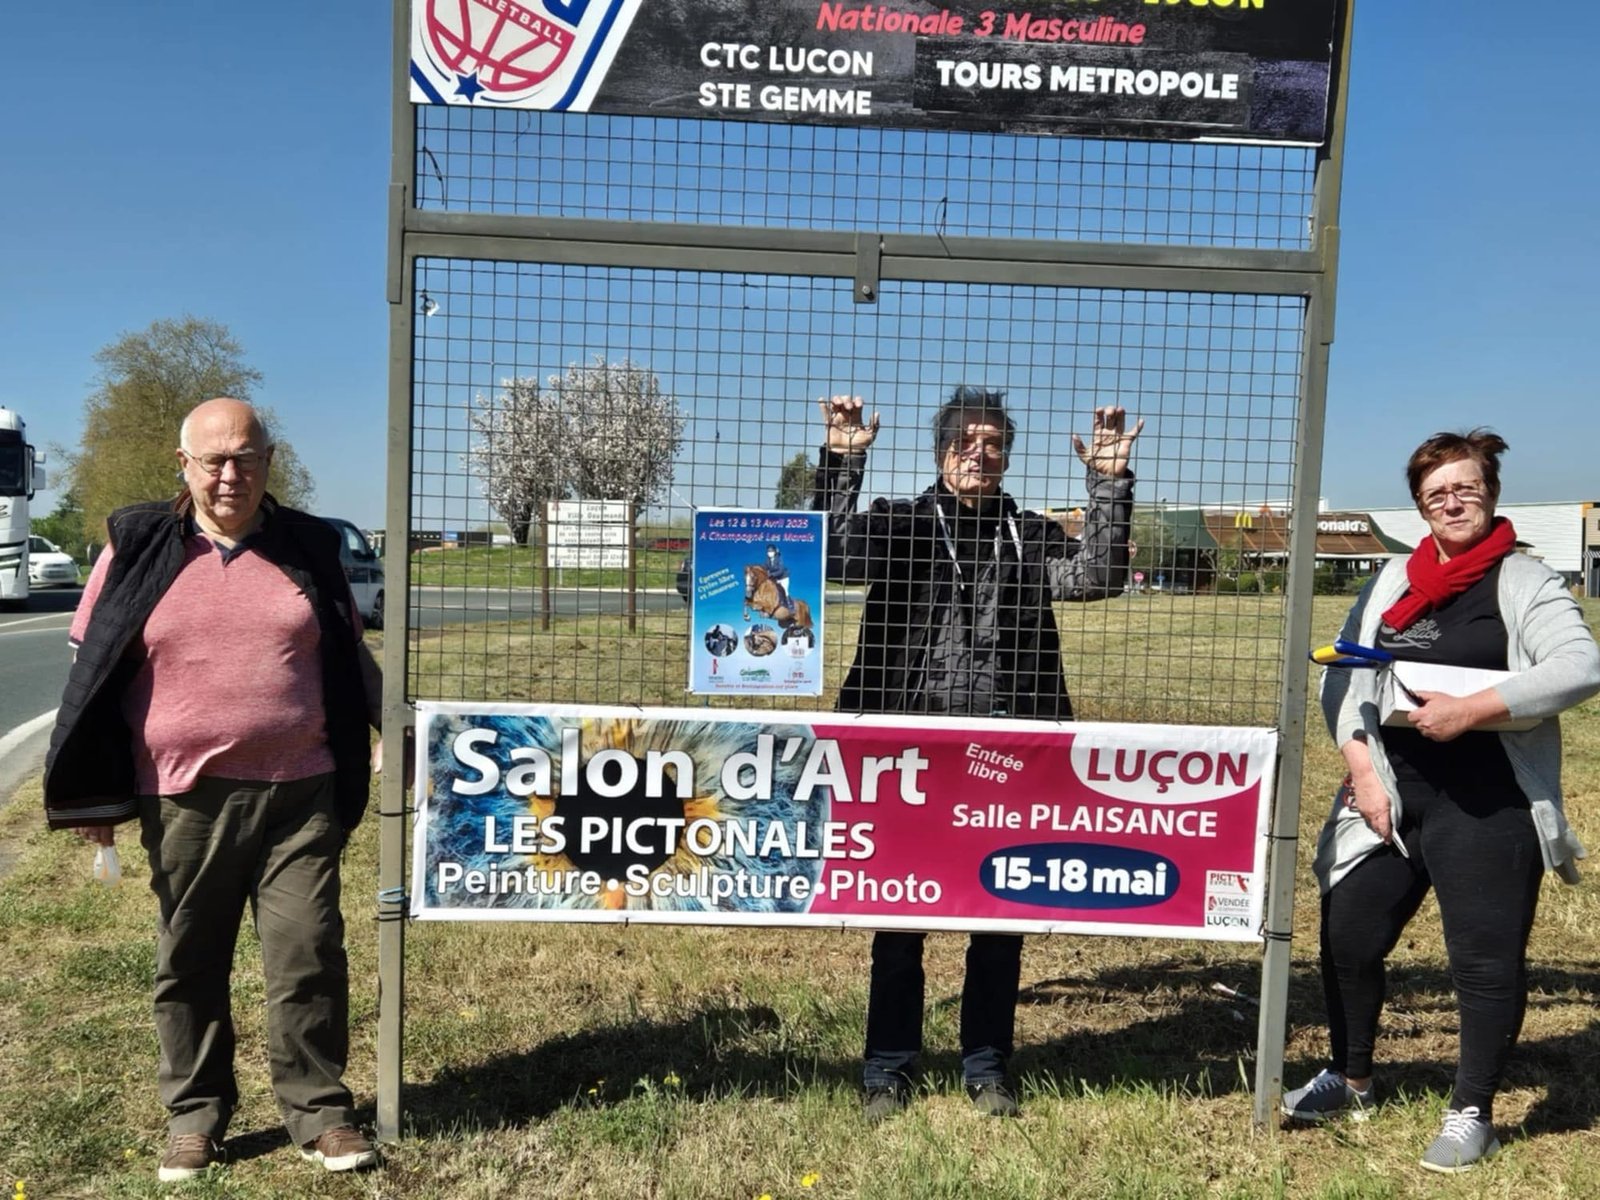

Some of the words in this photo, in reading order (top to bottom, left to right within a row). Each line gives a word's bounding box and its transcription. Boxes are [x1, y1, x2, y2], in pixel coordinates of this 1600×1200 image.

[816, 2, 963, 37] Nationale
[974, 11, 996, 37] 3
[1003, 12, 1147, 45] Masculine
[700, 42, 760, 71] CTC
[769, 45, 874, 76] LUCON
[937, 60, 1042, 92] TOURS
[1050, 66, 1239, 100] METROPOLE
[698, 82, 751, 110] STE
[760, 84, 872, 116] GEMME
[727, 518, 738, 528] 12
[751, 518, 761, 528] 13
[452, 727, 694, 799] Salon
[966, 742, 1024, 771] Entrée
[968, 760, 1008, 784] libre
[1086, 748, 1250, 794] LUÇON
[485, 815, 566, 854] LES
[580, 815, 875, 860] PICTONALES
[952, 803, 1021, 829] Salle
[1030, 803, 1218, 838] PLAISANCE
[991, 856, 1093, 892] 15-18
[1094, 862, 1167, 896] mai
